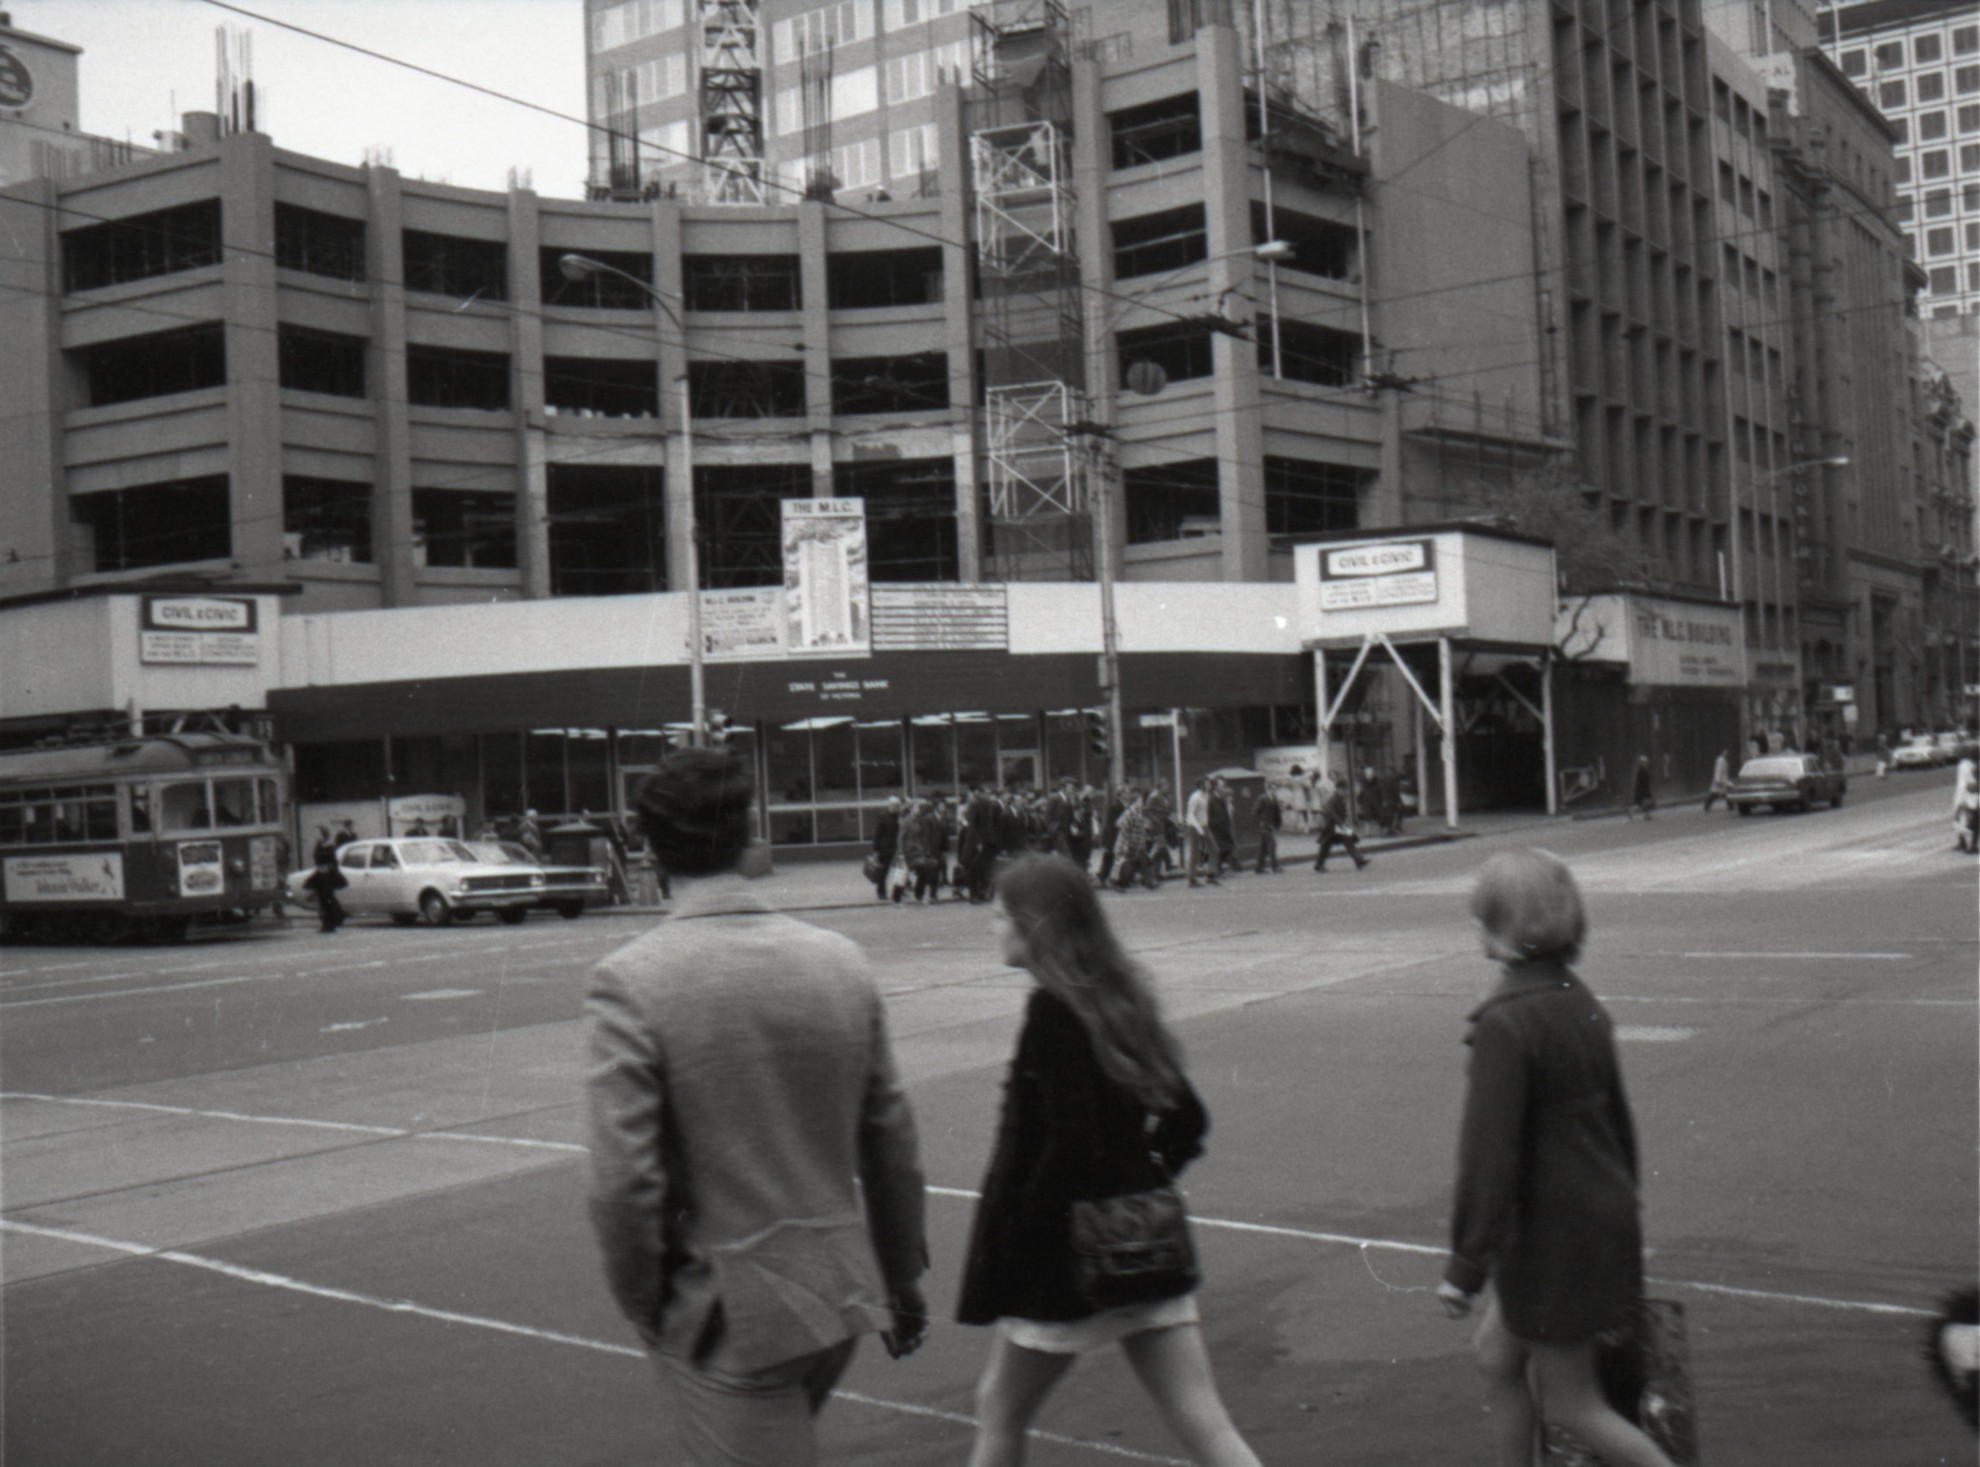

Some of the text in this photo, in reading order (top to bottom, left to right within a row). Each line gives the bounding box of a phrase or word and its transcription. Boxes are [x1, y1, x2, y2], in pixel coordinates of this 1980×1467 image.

[793, 503, 813, 512] THE
[1338, 556, 1369, 568] CIVIL
[1381, 550, 1414, 564] CIVIC
[162, 606, 192, 619] CIVIL
[205, 607, 238, 620] CIVIC
[863, 680, 889, 689] BANK
